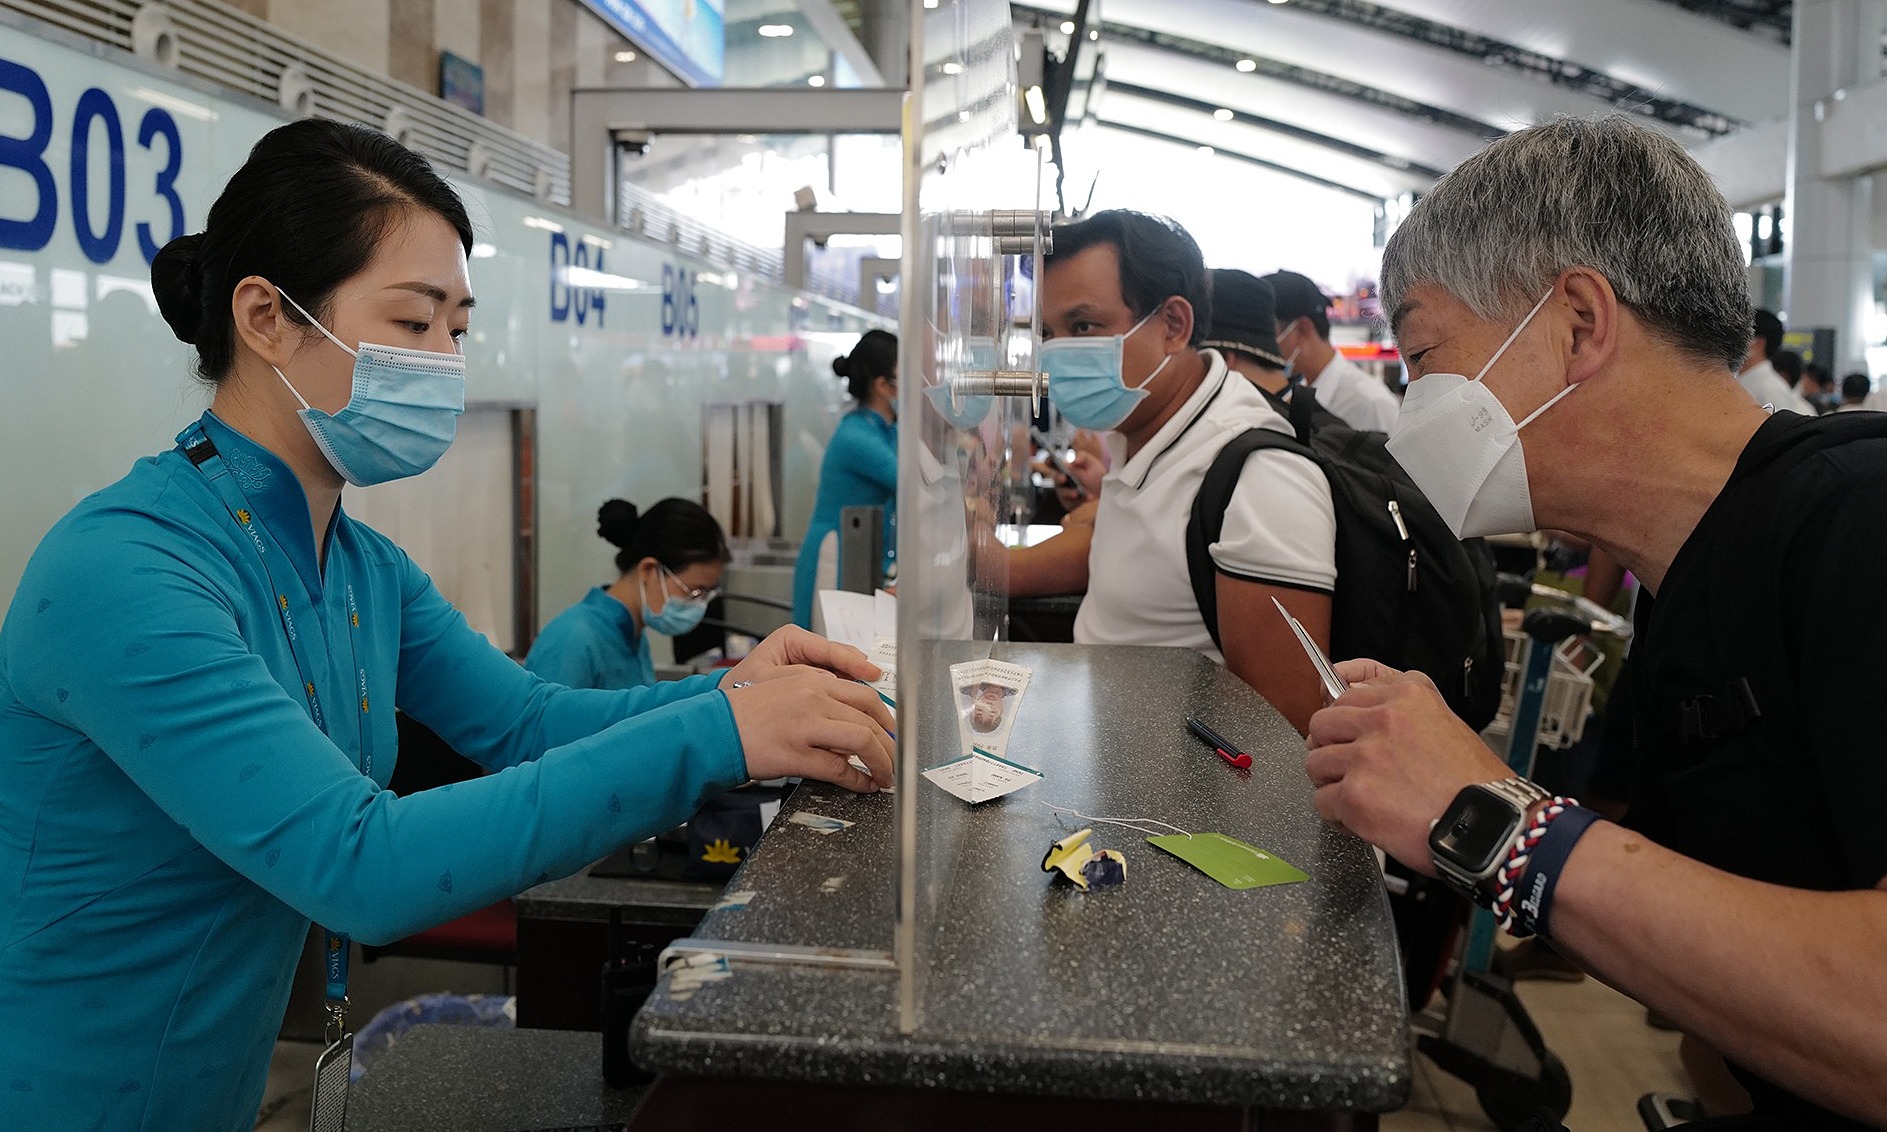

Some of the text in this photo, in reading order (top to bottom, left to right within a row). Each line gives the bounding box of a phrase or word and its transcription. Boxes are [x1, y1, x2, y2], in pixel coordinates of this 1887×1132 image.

[0, 58, 185, 266] B03
[1474, 416, 1494, 432] MASK
[247, 524, 266, 553] VIAGS
[348, 584, 357, 612] VIAGS
[285, 610, 297, 641] VIAGS
[360, 668, 368, 697] VIAGS
[331, 951, 340, 980] VIAGS
